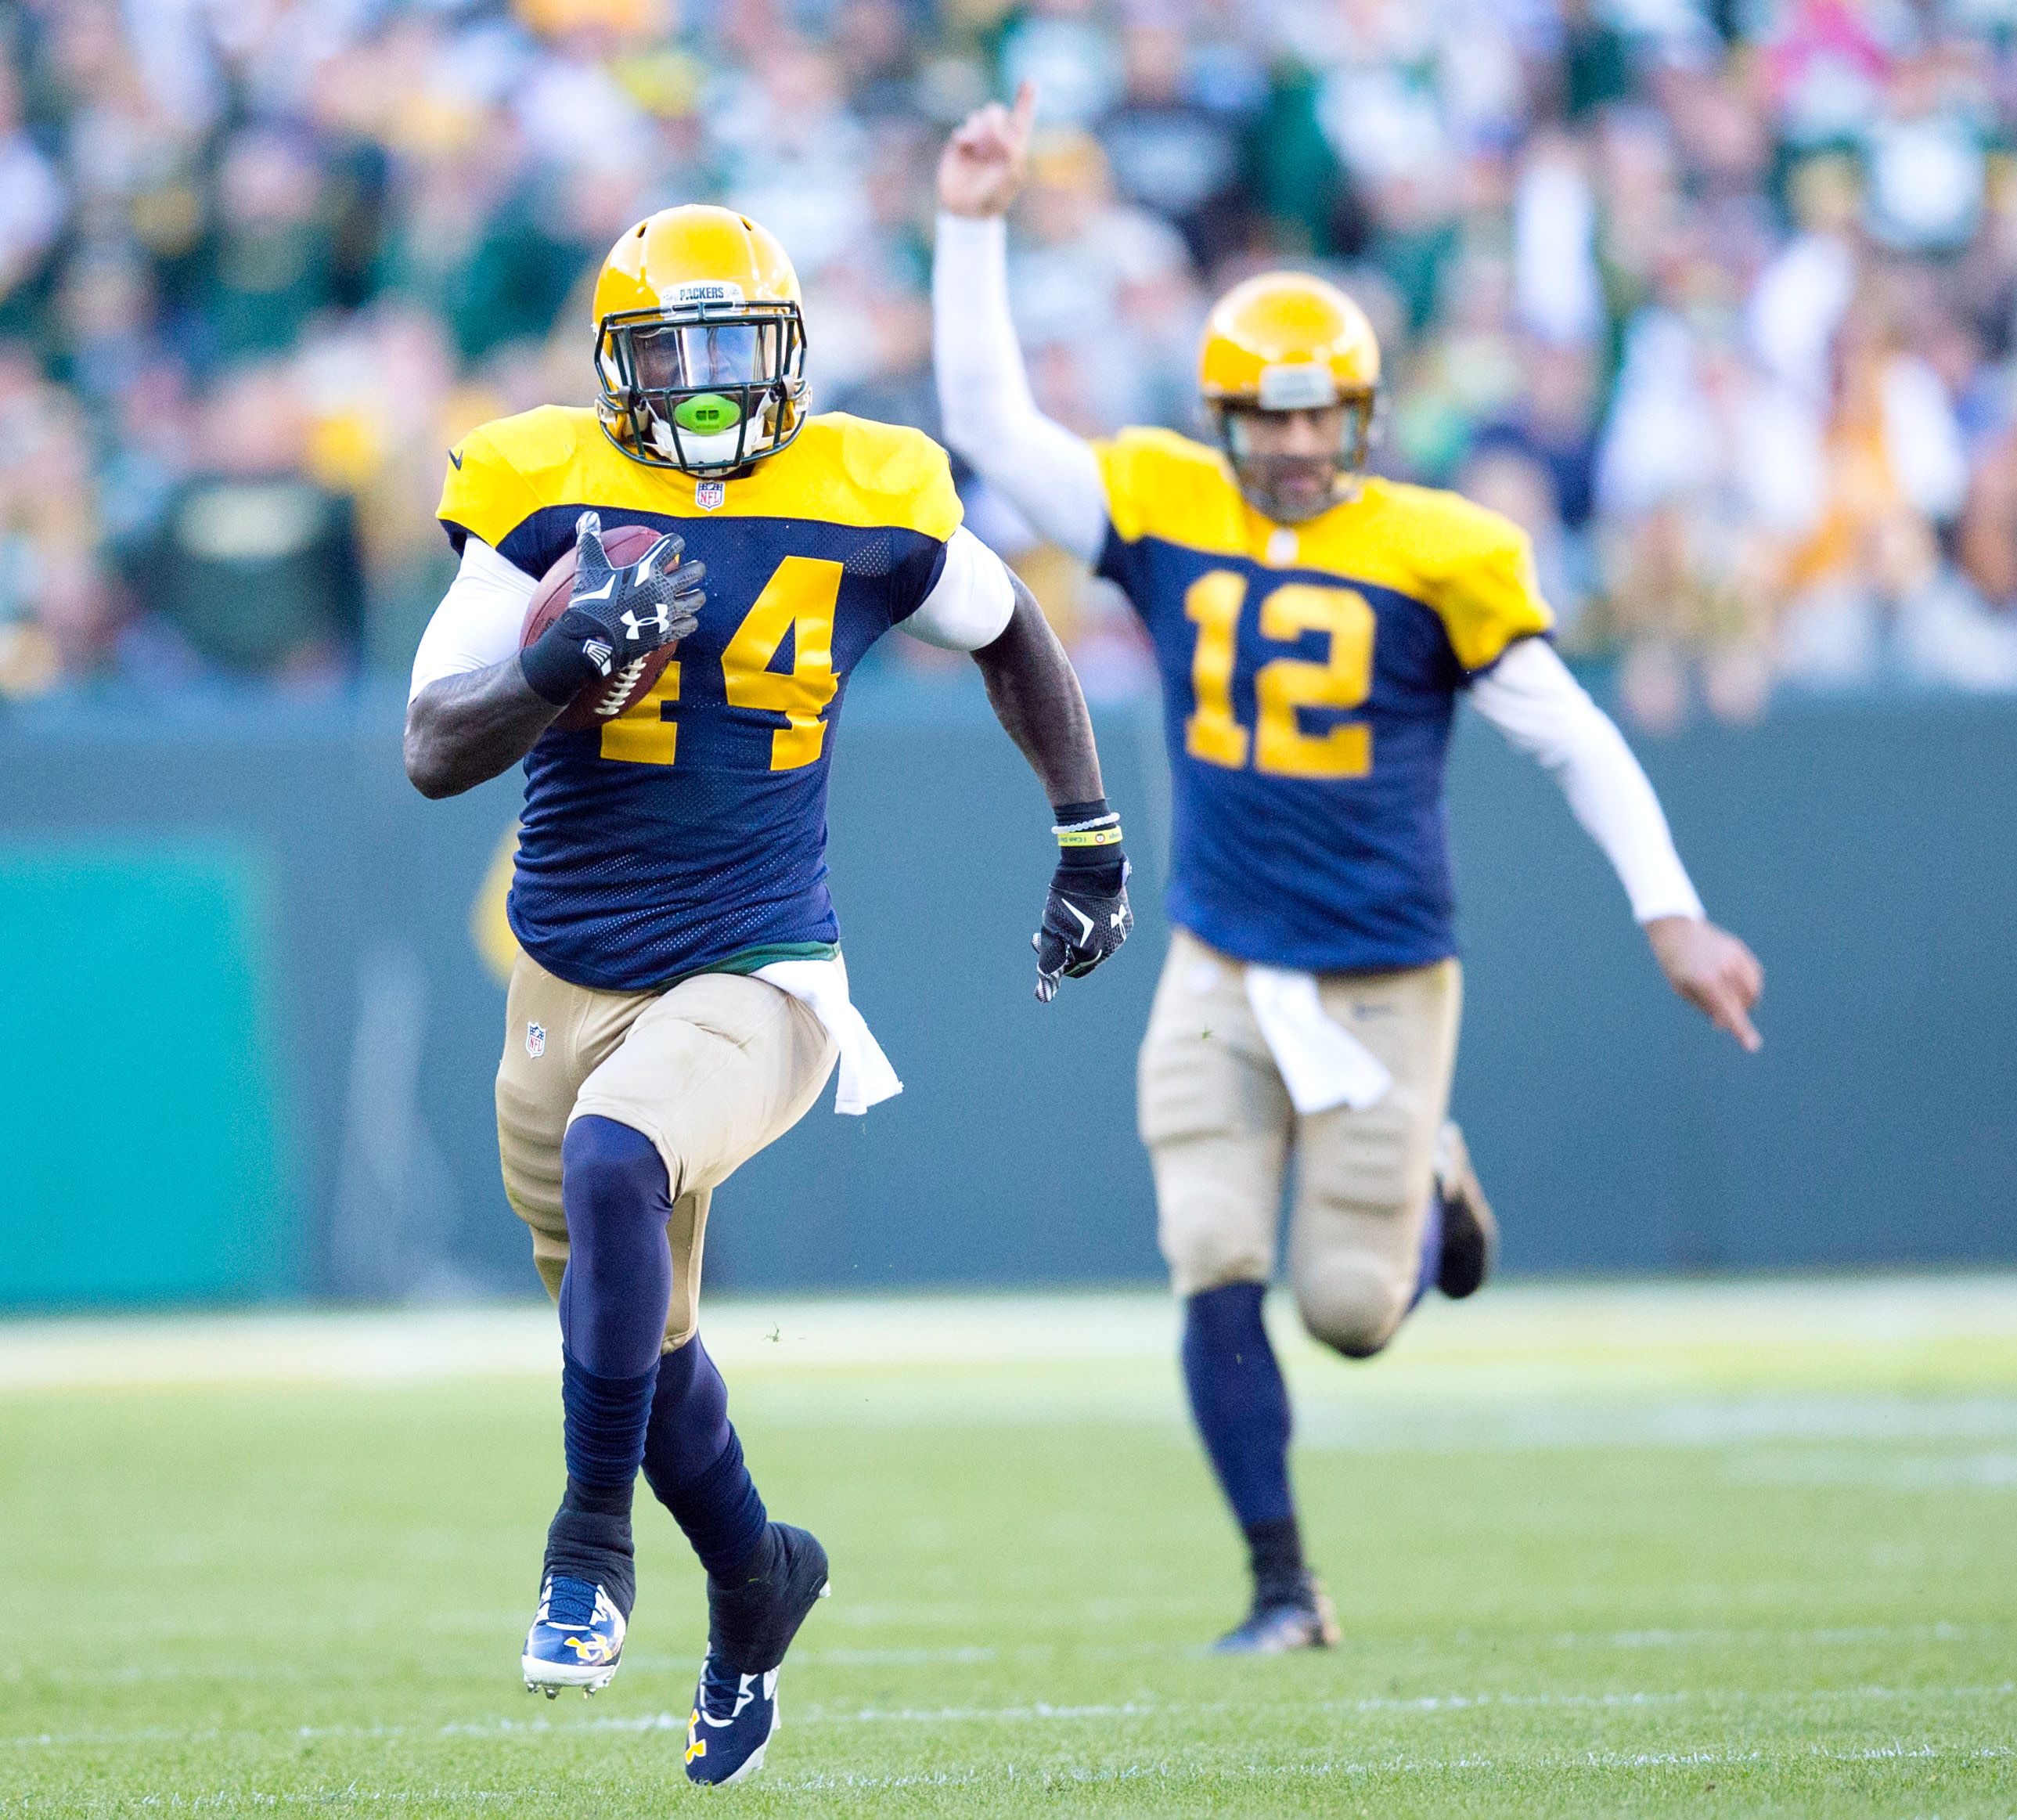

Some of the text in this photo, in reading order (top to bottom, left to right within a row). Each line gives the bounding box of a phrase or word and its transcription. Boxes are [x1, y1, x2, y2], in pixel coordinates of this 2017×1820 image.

[679, 287, 724, 301] PACKERS
[700, 491, 719, 505] NFL
[1185, 569, 1376, 778] 12
[530, 1036, 542, 1051] NFL
